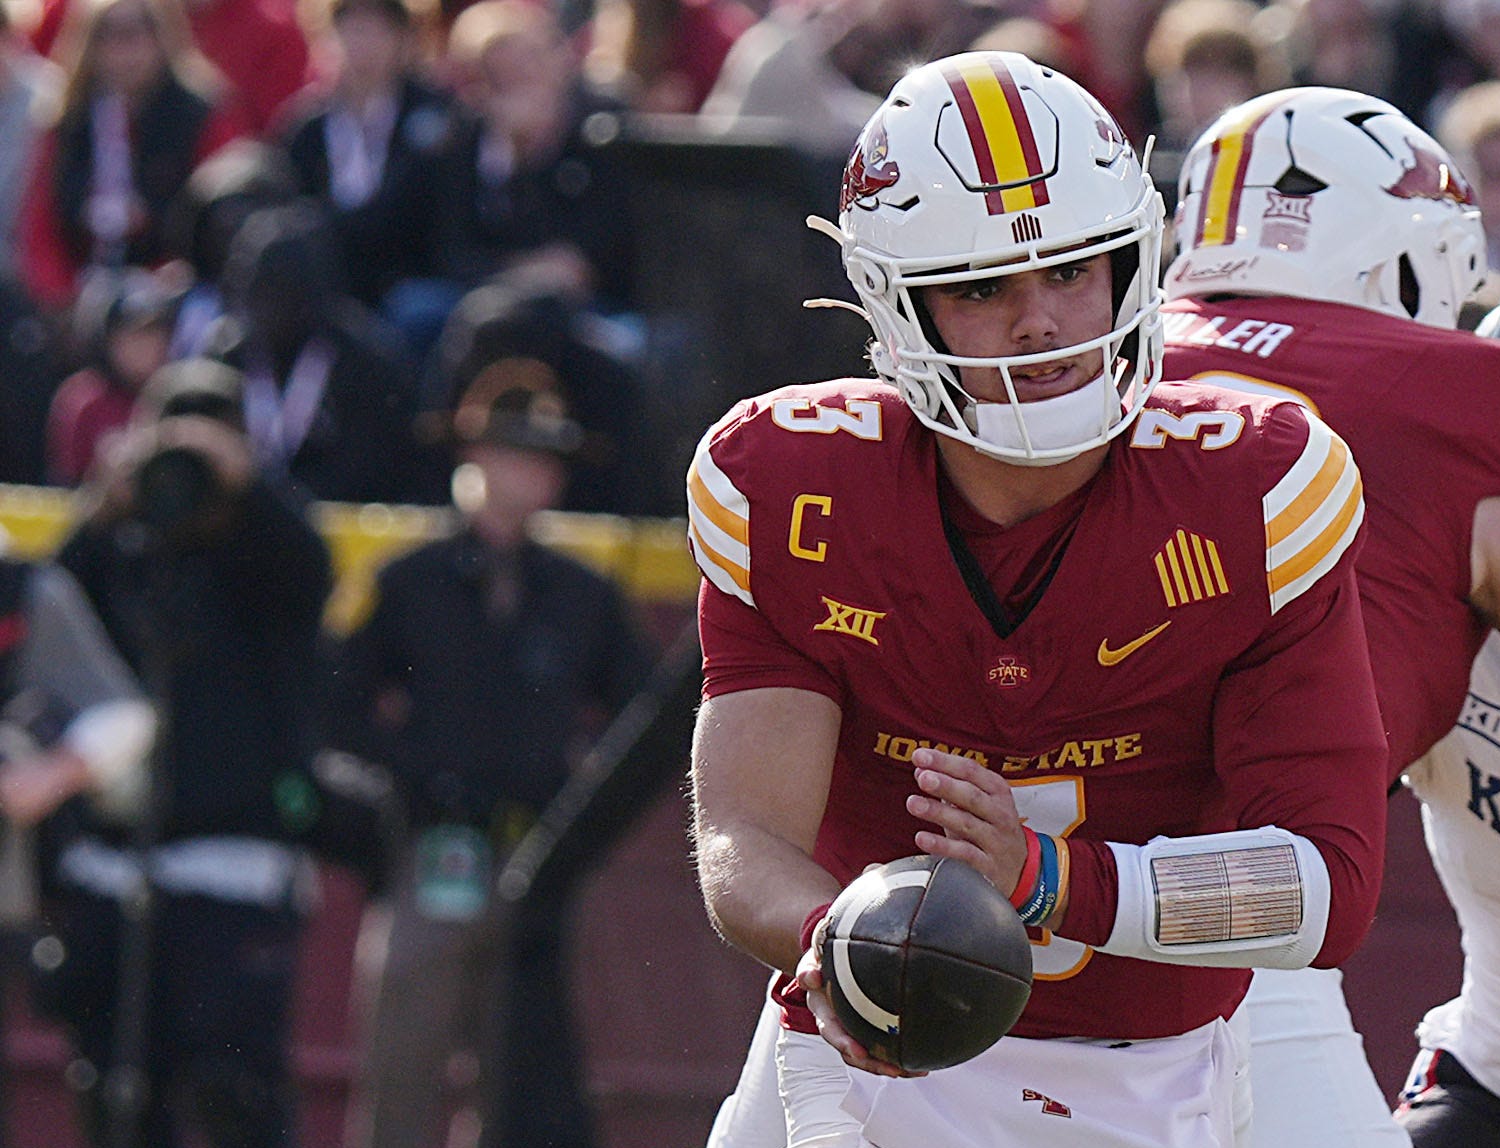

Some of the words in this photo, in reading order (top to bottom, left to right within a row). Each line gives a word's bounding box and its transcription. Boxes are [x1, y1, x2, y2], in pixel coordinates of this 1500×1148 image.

[1163, 313, 1295, 359] ILLER
[771, 398, 883, 442] 3
[1129, 407, 1246, 450] 3
[788, 494, 833, 562] C
[813, 596, 887, 646] XII
